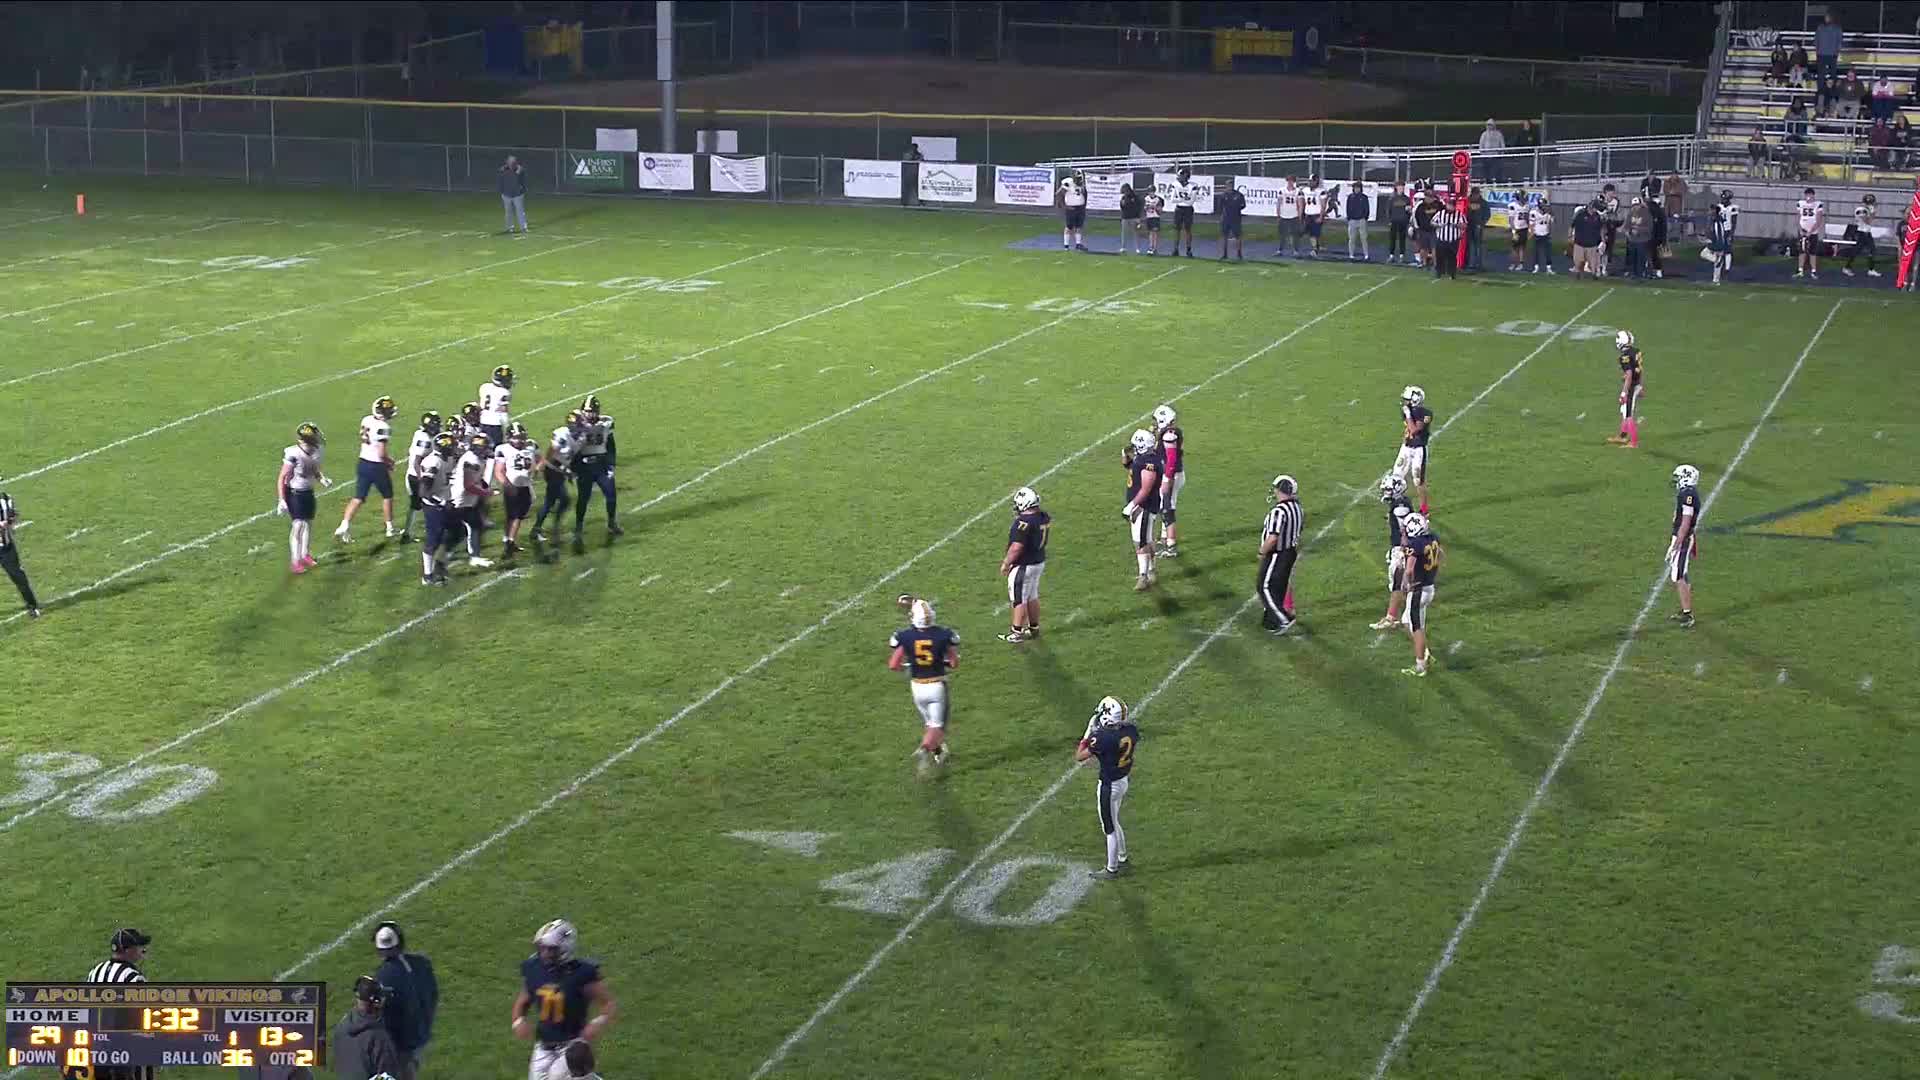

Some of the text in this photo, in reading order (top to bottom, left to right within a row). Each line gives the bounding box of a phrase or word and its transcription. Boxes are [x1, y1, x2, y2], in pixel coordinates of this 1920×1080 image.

[914, 639, 933, 667] 5
[1118, 736, 1133, 768] 2
[819, 847, 1096, 927] 40
